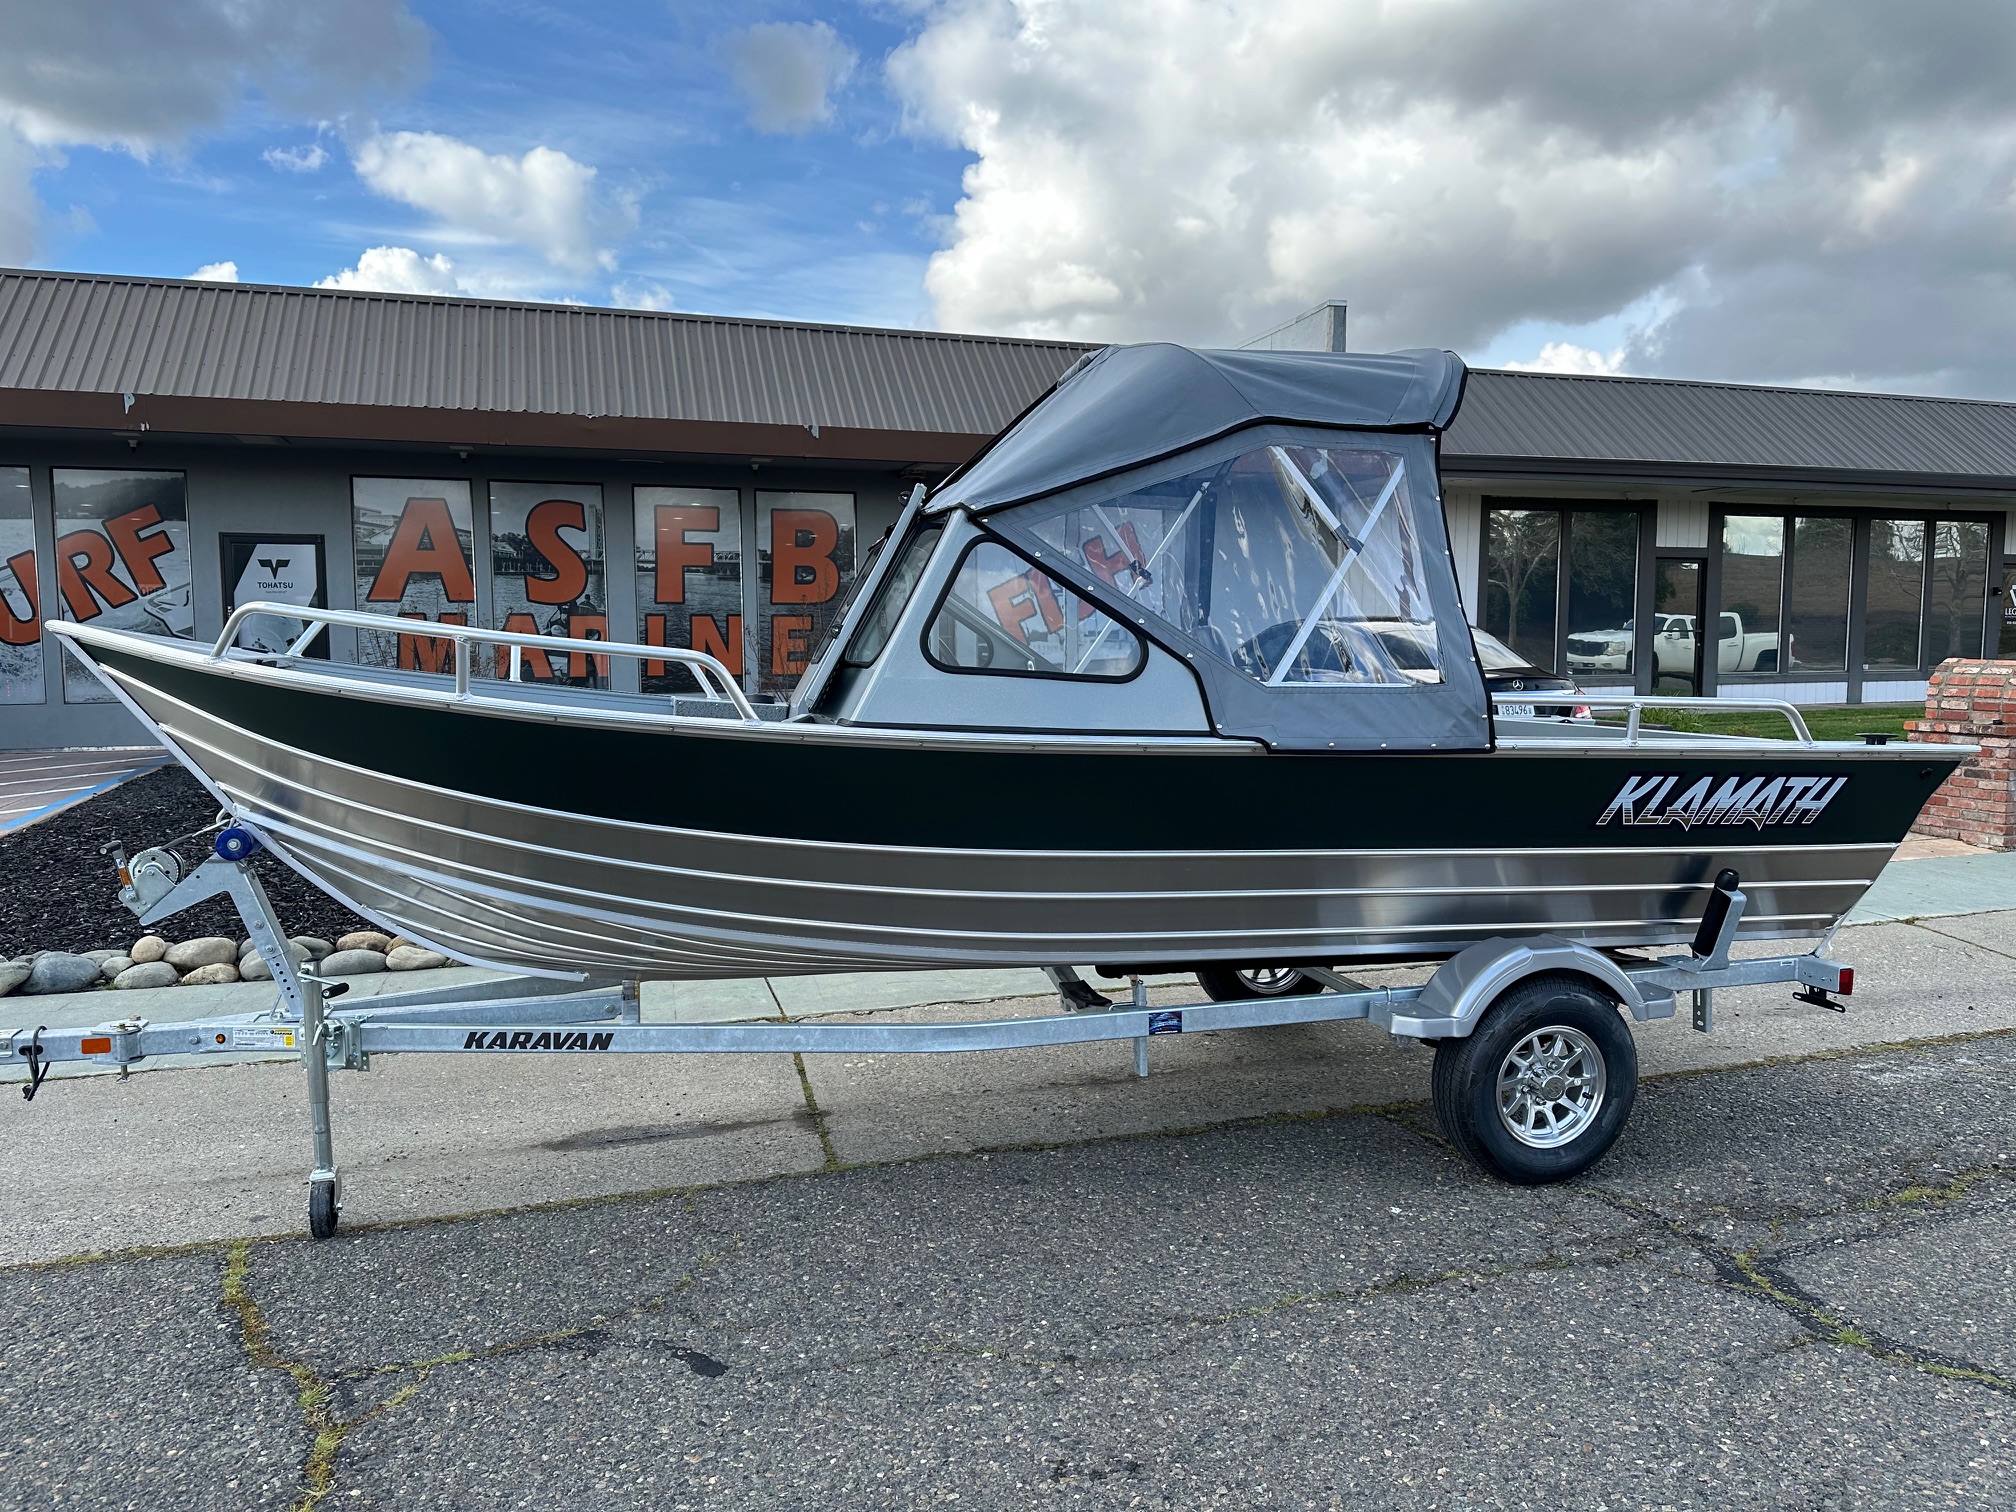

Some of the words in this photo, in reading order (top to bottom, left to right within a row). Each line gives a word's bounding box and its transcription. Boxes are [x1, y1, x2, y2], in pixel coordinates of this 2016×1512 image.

[365, 497, 841, 605] ASFB
[257, 581, 294, 589] TOHATSU
[985, 520, 1154, 647] FIH
[397, 612, 814, 678] MARINE
[1595, 775, 1849, 832] KLAMATH
[463, 1031, 615, 1051] KARAVAN
